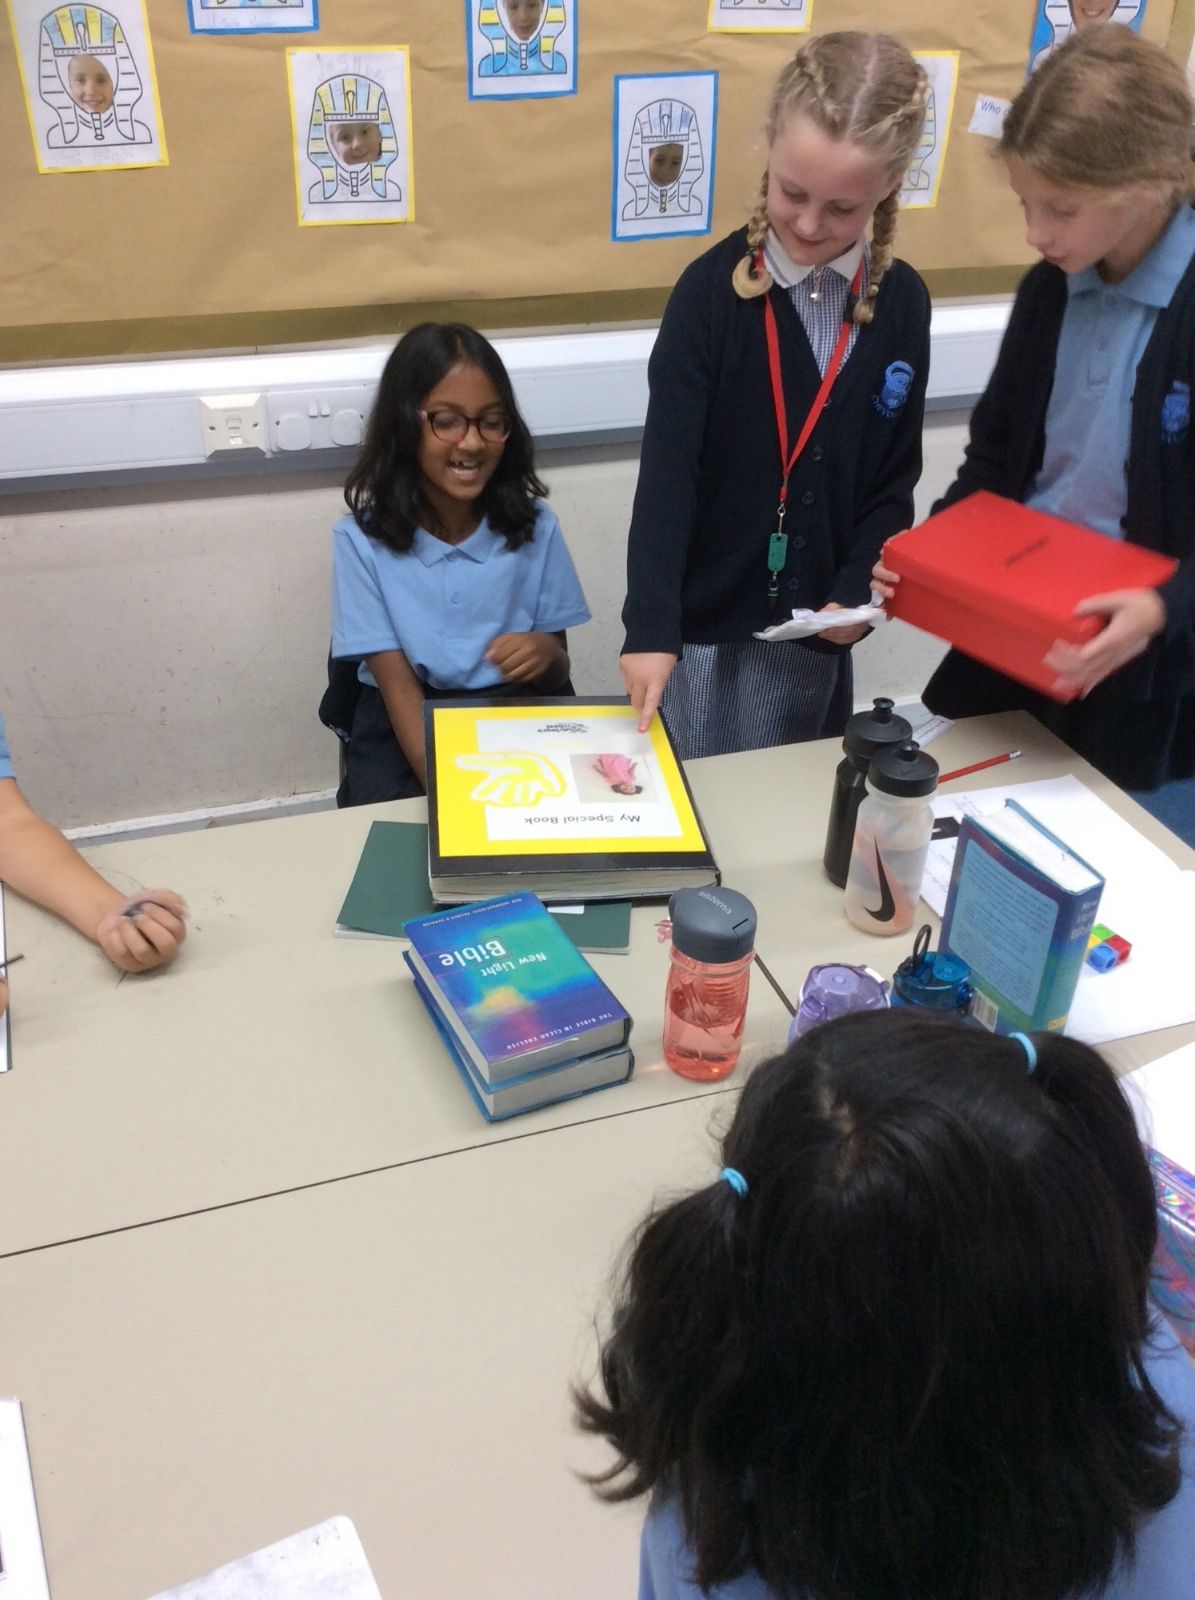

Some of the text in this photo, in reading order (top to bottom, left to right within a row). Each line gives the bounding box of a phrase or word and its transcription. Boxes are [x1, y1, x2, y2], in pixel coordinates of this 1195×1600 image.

[981, 100, 1001, 114] Who
[524, 813, 641, 825] My Special Book
[438, 940, 506, 967] Bible
[480, 952, 546, 977] New Light
[506, 1012, 612, 1050] THE BIBLE IN CLEAR ENGLISH
